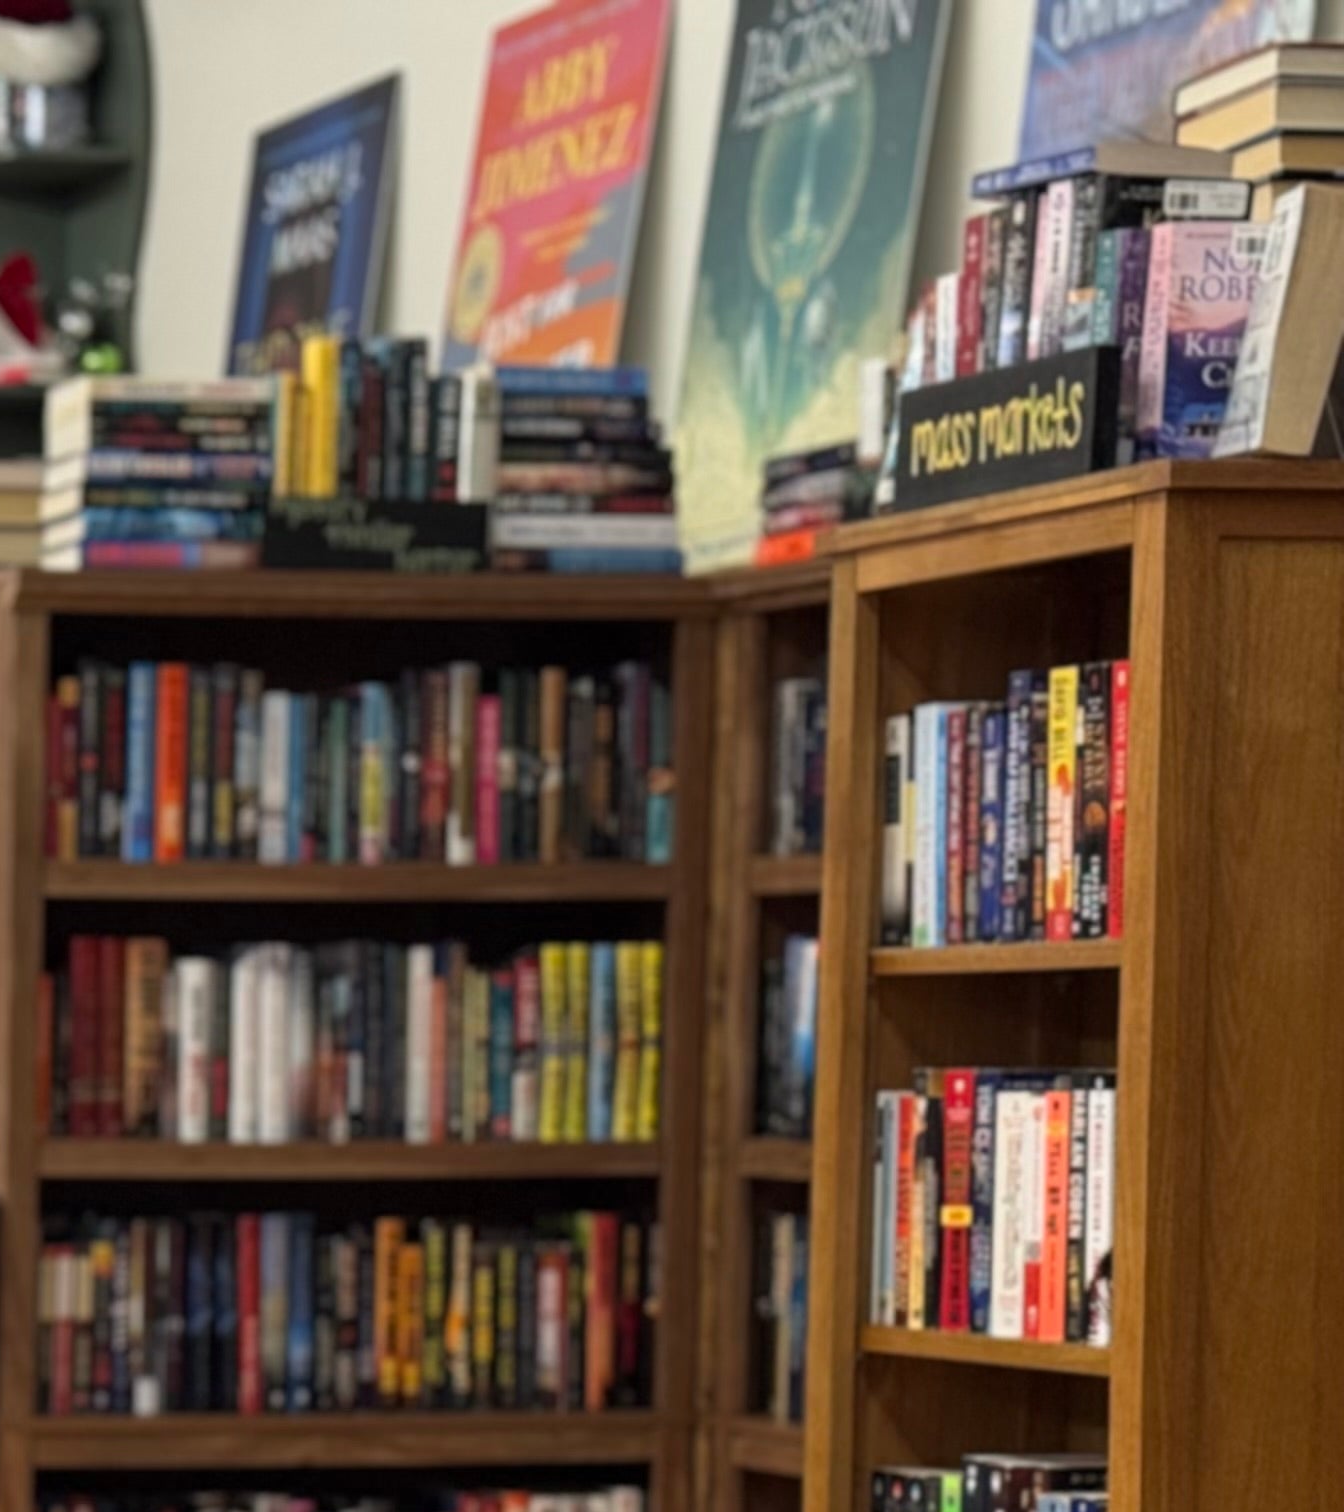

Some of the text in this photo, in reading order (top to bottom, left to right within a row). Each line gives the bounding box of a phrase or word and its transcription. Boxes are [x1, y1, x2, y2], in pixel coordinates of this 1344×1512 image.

[1180, 275, 1260, 302] ROBE
[910, 376, 1085, 478] mass markets
